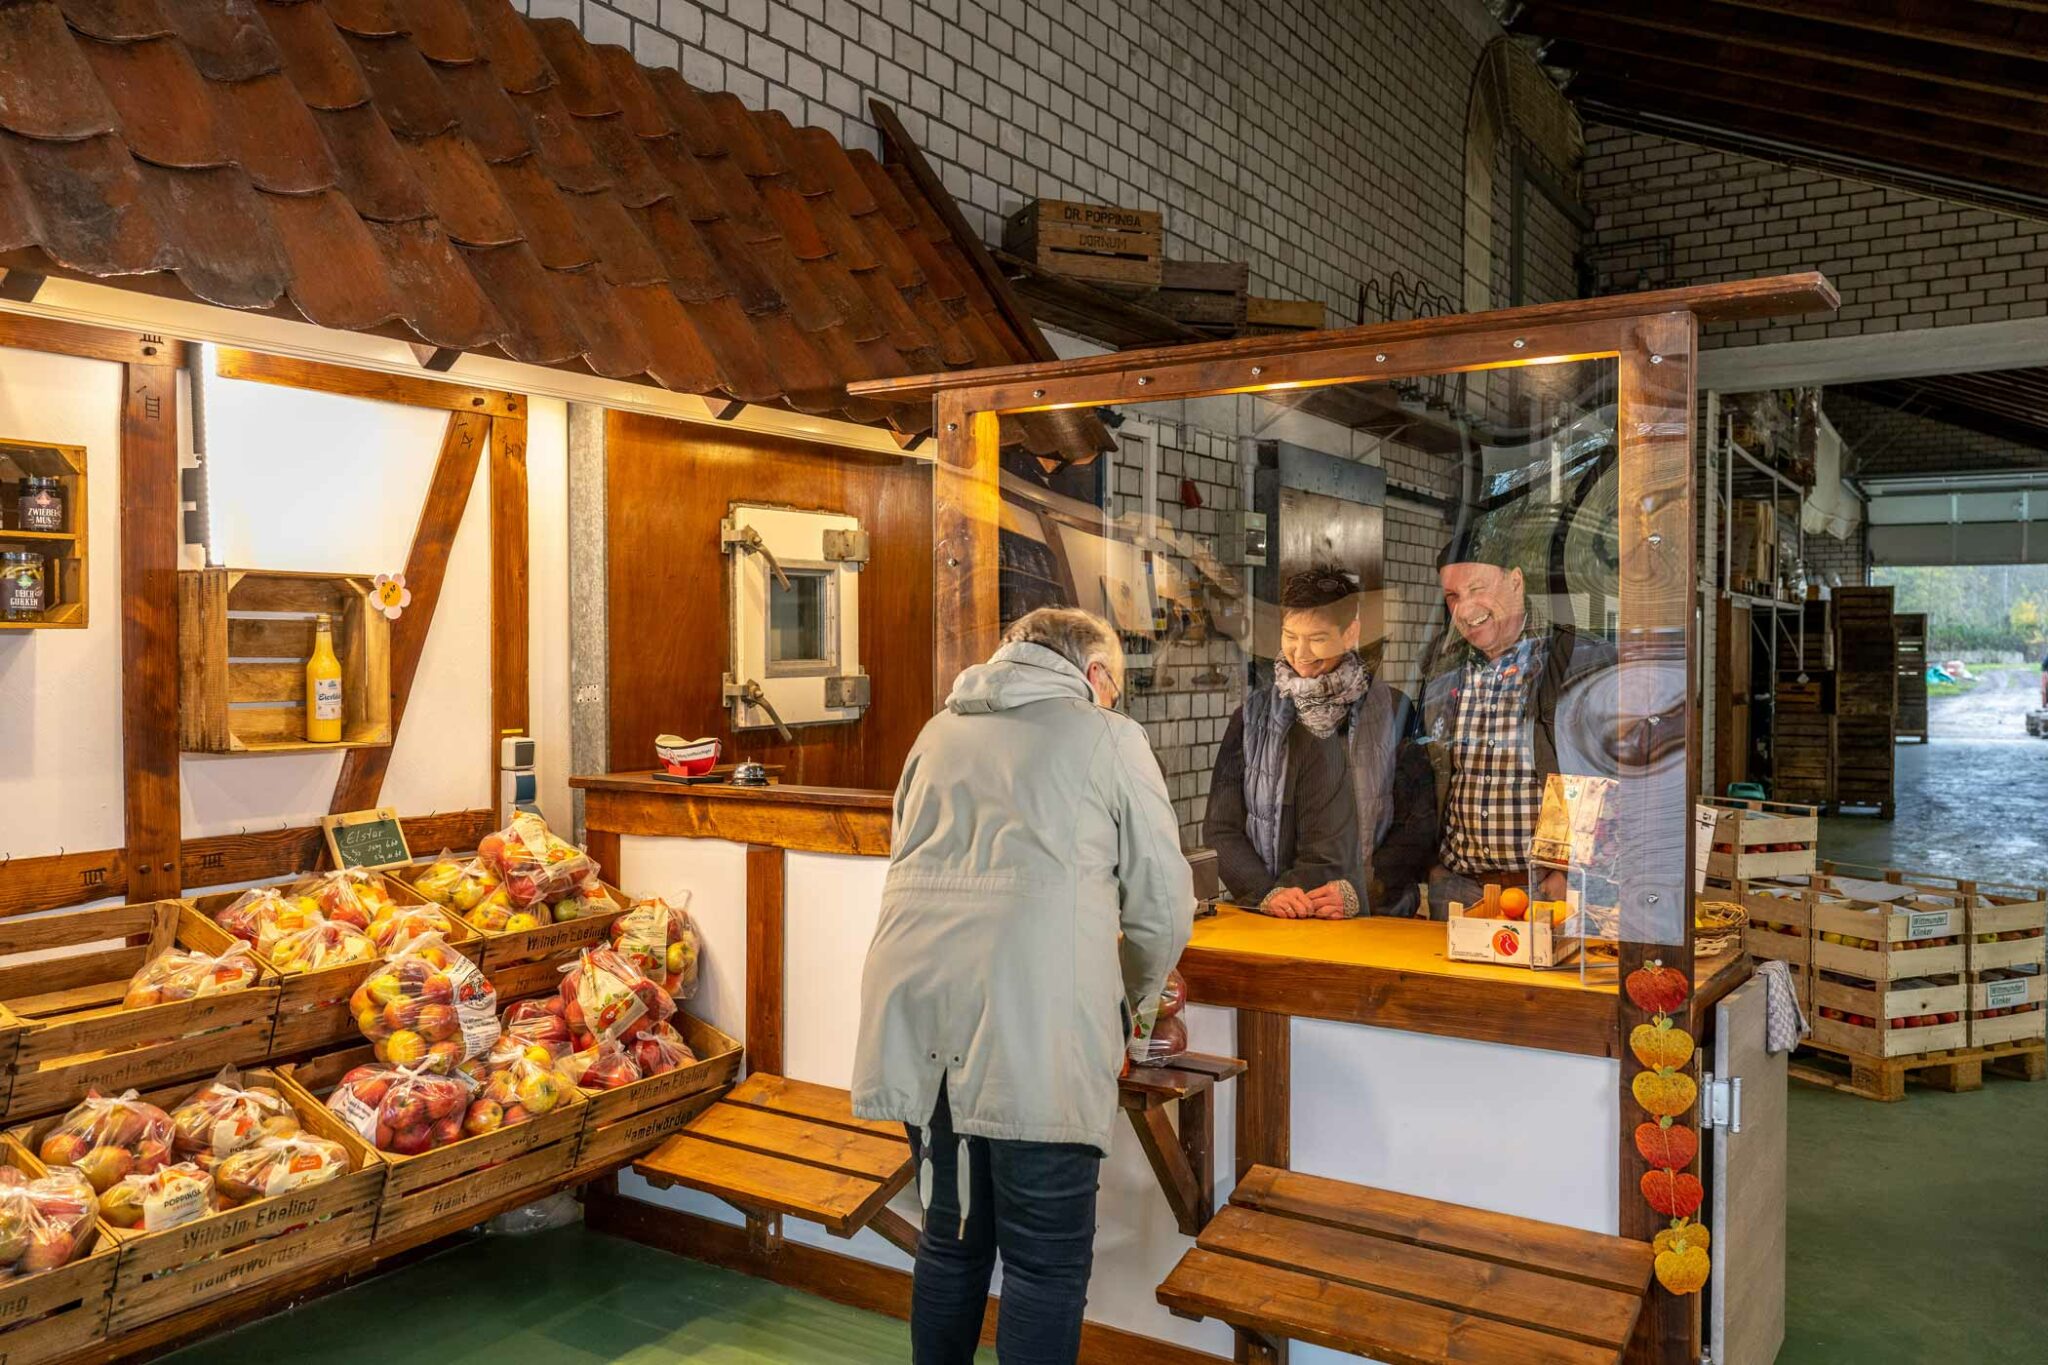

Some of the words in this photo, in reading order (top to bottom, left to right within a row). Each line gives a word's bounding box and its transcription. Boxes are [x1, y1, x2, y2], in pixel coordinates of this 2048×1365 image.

[1085, 209, 1142, 227] POPPINGA
[1079, 233, 1128, 250] DORNUM
[527, 930, 569, 952] Wilhelm
[569, 926, 609, 943] Ebeling
[630, 1079, 671, 1101] Wilhelm
[671, 1065, 710, 1088] Ebeling
[164, 1188, 202, 1208] POPPINGA
[182, 1219, 250, 1249] Wilhelm
[255, 1198, 318, 1229] Ebeling
